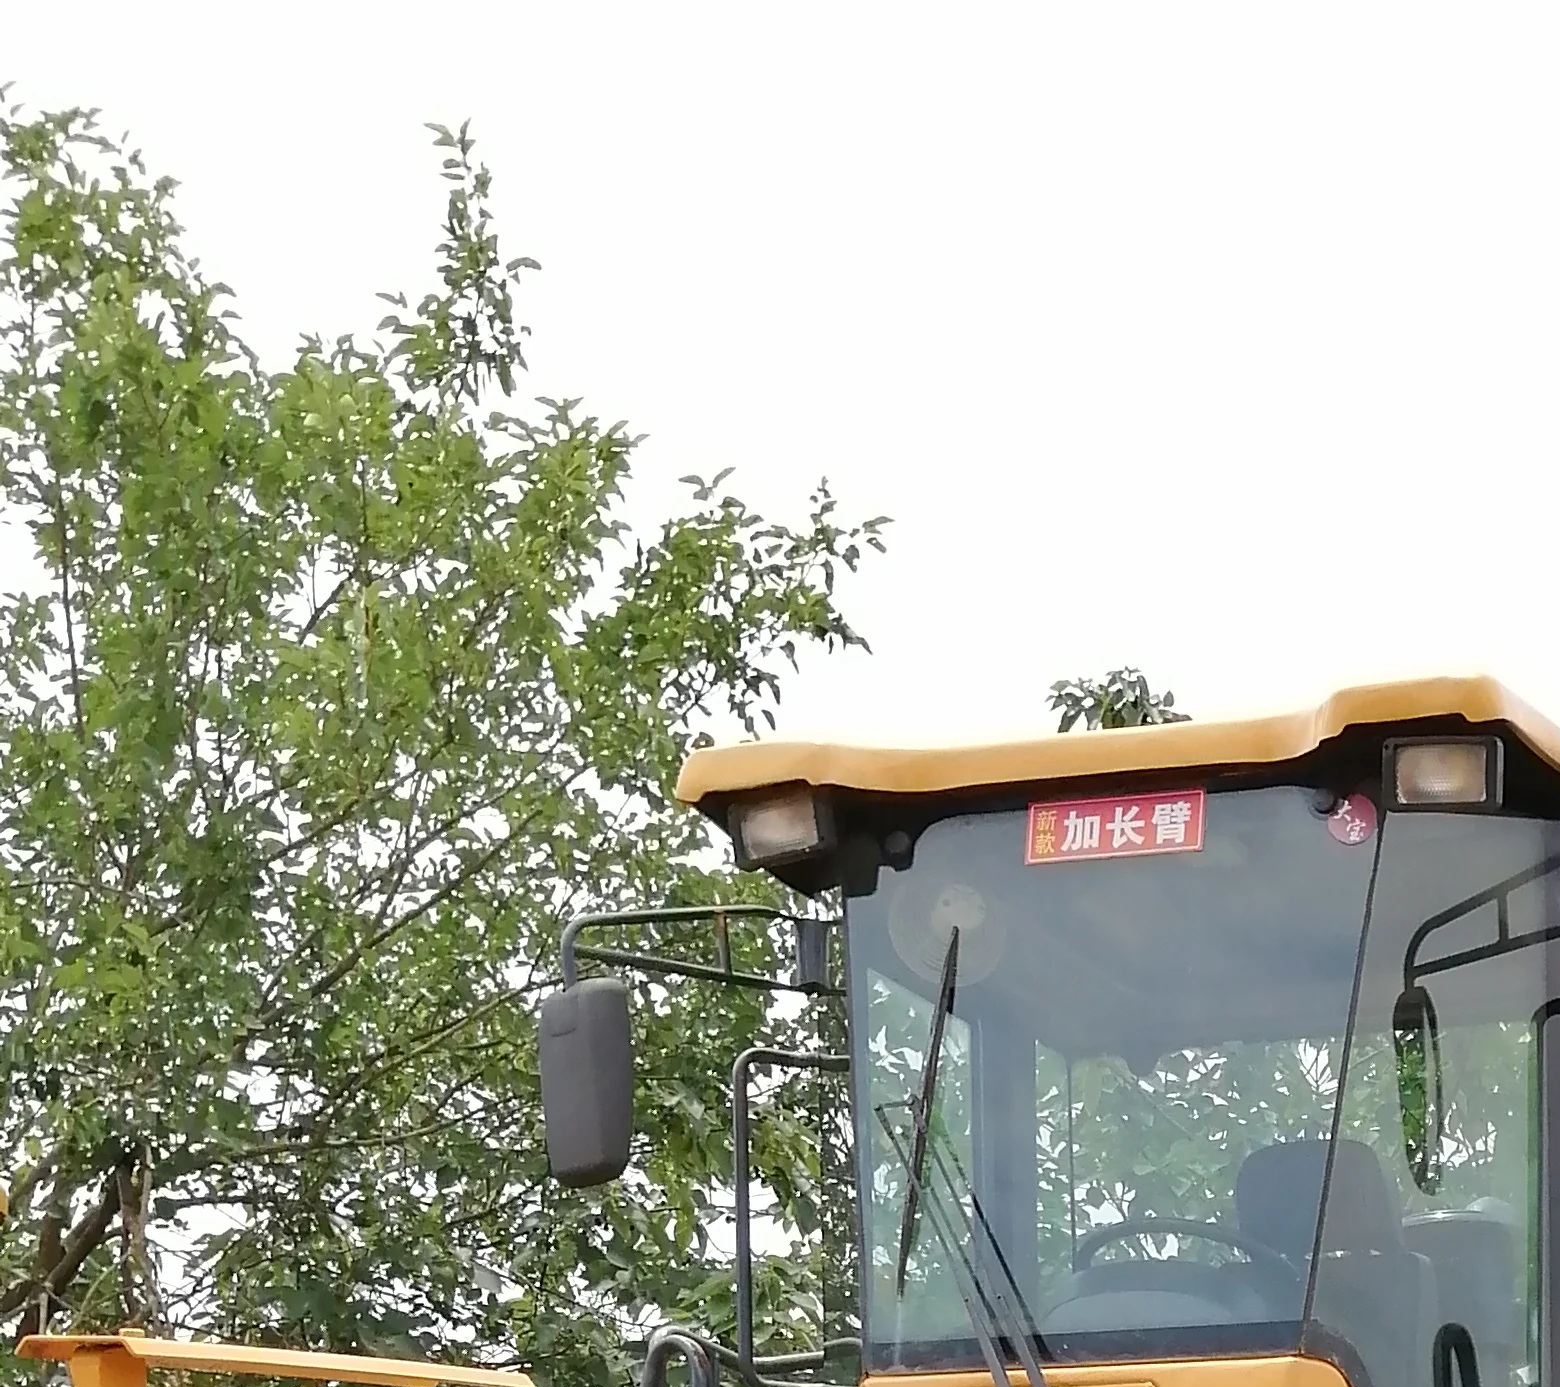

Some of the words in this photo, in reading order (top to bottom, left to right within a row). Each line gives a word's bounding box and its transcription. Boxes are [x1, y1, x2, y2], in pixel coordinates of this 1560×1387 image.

[1034, 809, 1058, 855] 新款
[1060, 800, 1192, 852] 加长臂
